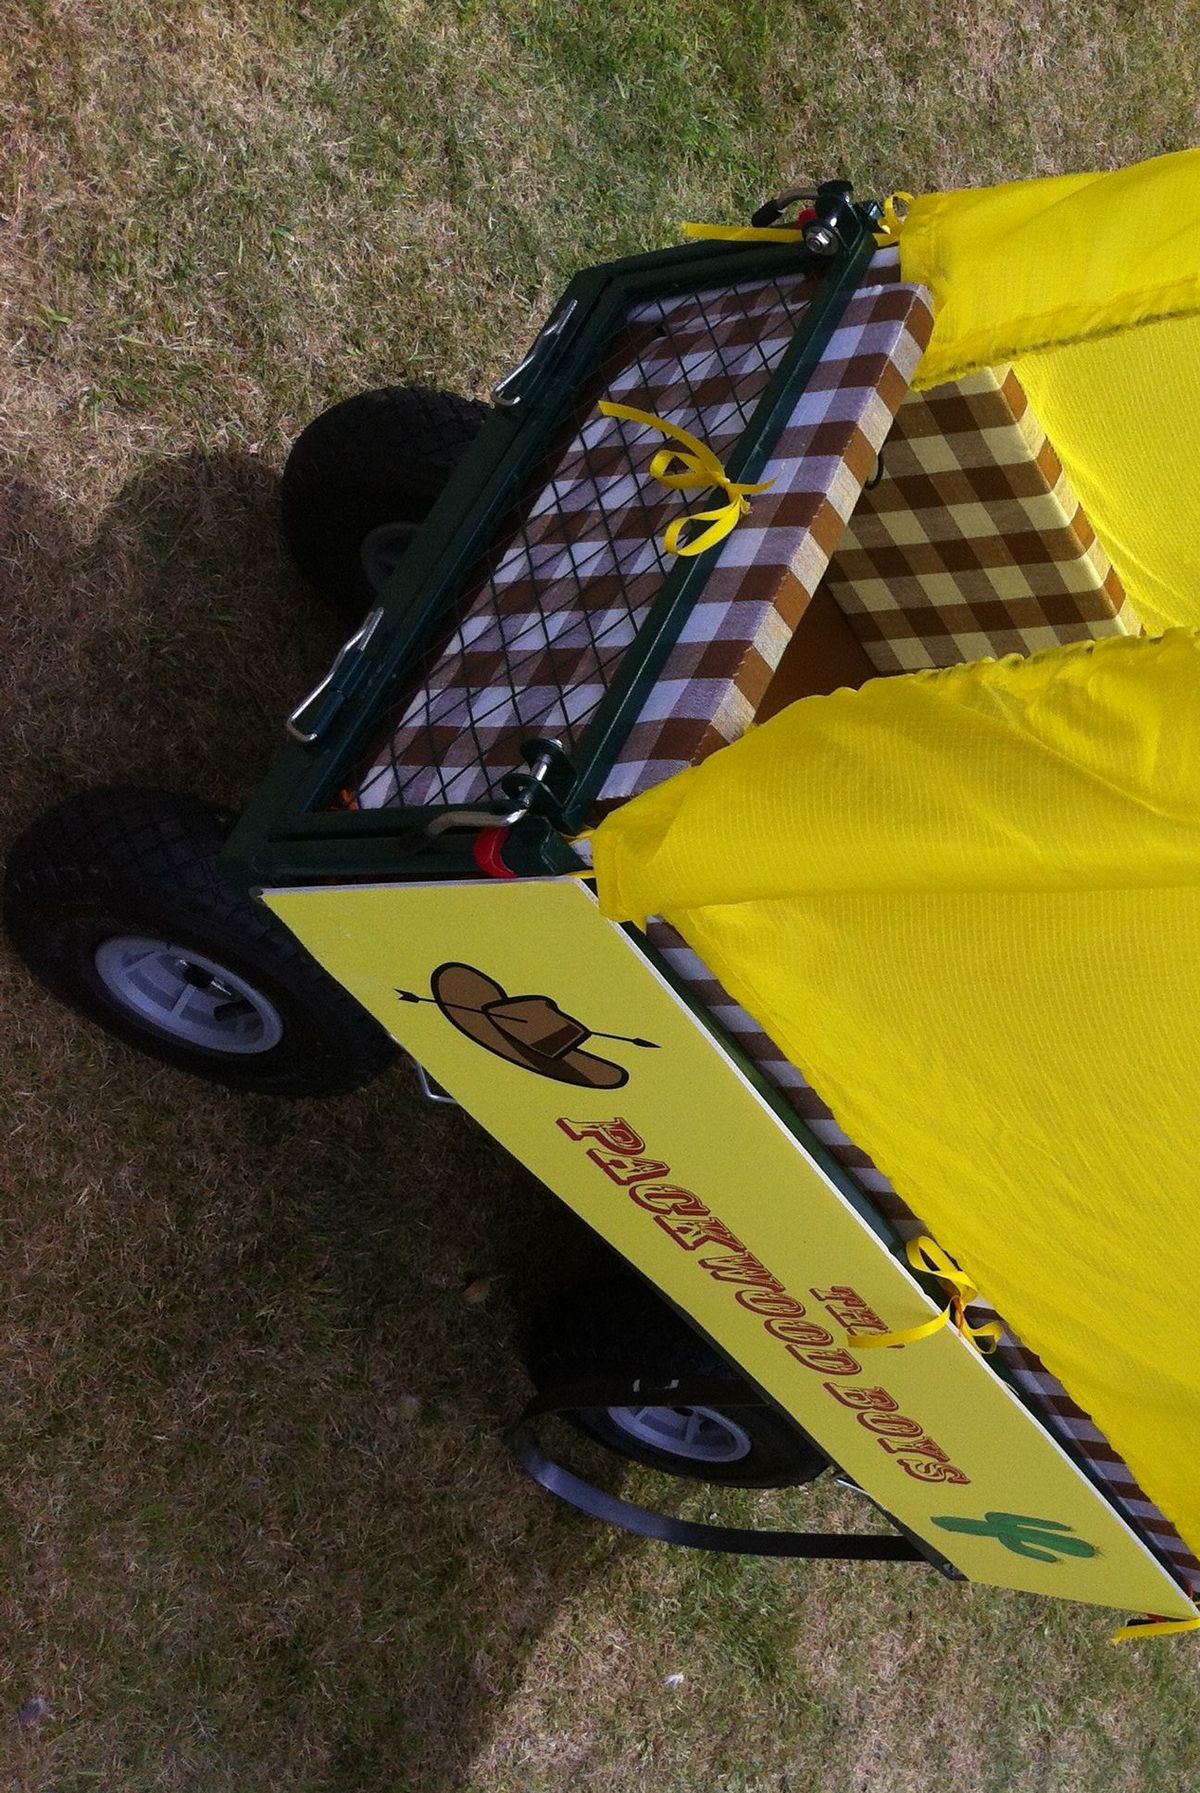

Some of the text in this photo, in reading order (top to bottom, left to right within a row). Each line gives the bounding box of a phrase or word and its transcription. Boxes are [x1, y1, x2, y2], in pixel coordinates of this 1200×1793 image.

[555, 1116, 971, 1485] PACKWOOD BOYS
[808, 1285, 906, 1349] TH
